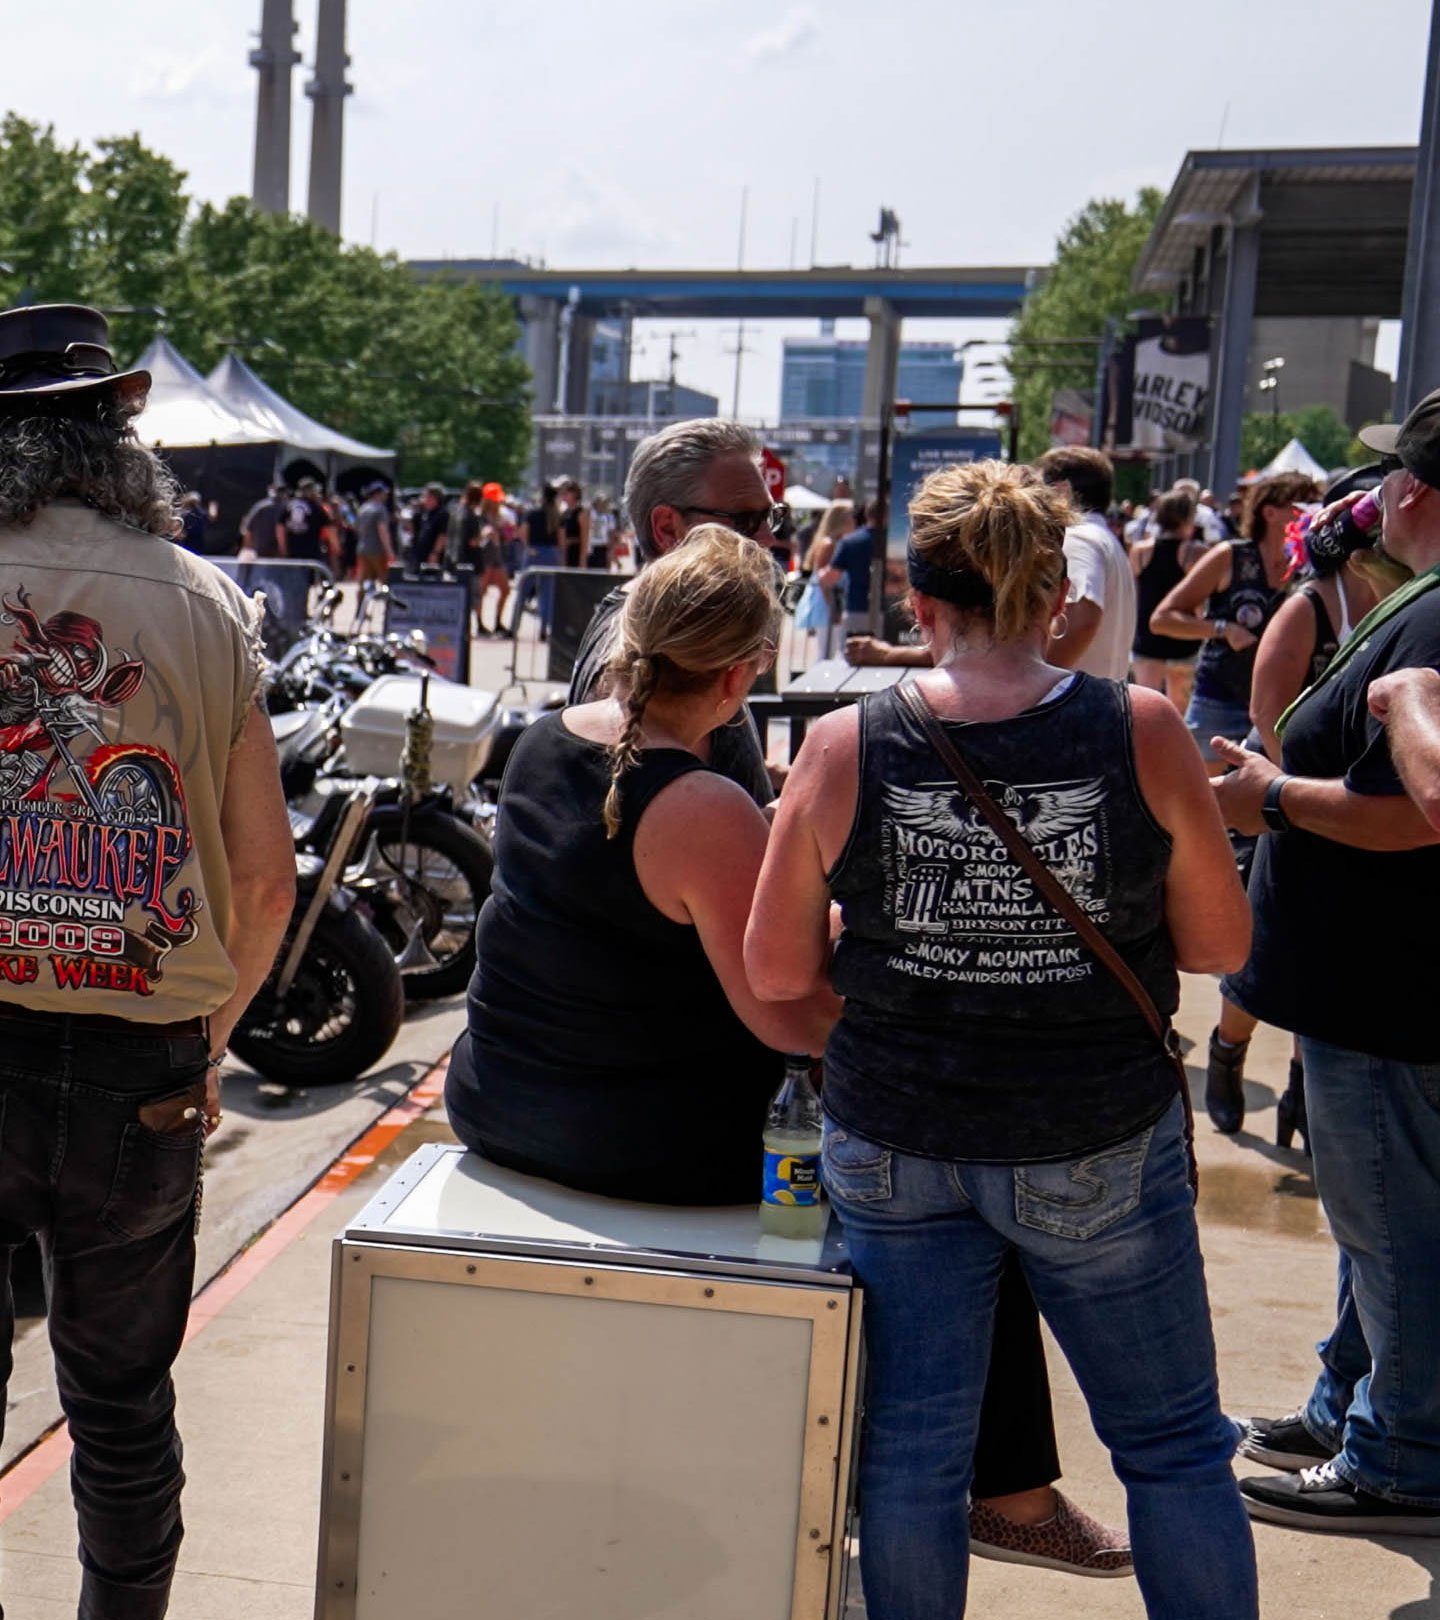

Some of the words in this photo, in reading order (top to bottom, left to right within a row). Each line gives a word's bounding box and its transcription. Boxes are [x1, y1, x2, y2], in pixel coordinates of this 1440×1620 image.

[964, 864, 1022, 878] SMOKY
[951, 879, 1034, 900] MTNS
[942, 901, 1045, 916] NANTAHALA
[951, 919, 1026, 931] BRYSON
[1031, 918, 1072, 931] CIT
[904, 942, 971, 967] SMOKY
[977, 947, 1081, 968] MOUNTAIN
[51, 954, 155, 996] WEEK
[886, 956, 1025, 985] HARLEY-DAVIDSON
[1026, 962, 1094, 984] OUTPOST
